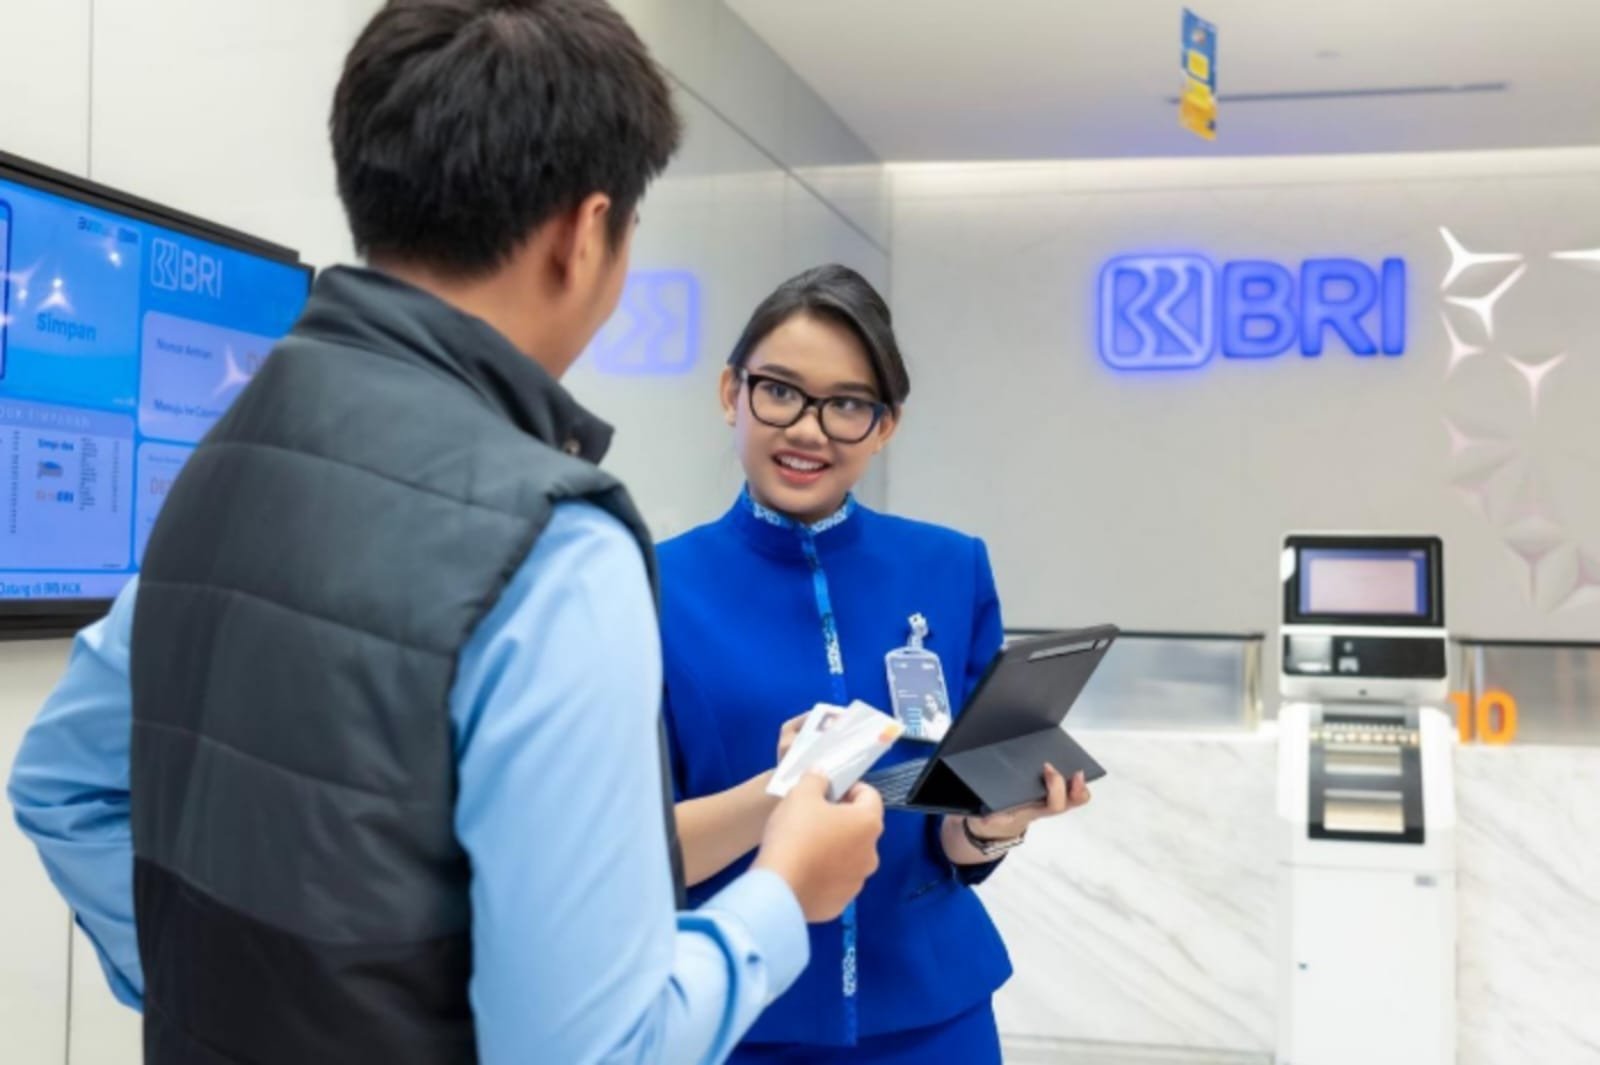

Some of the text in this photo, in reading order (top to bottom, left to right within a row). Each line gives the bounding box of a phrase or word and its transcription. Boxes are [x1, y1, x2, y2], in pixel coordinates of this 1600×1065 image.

[181, 251, 223, 298] BRI
[36, 312, 98, 343] Simpan
[1221, 257, 1406, 360] BRI
[1448, 686, 1518, 747] 10
